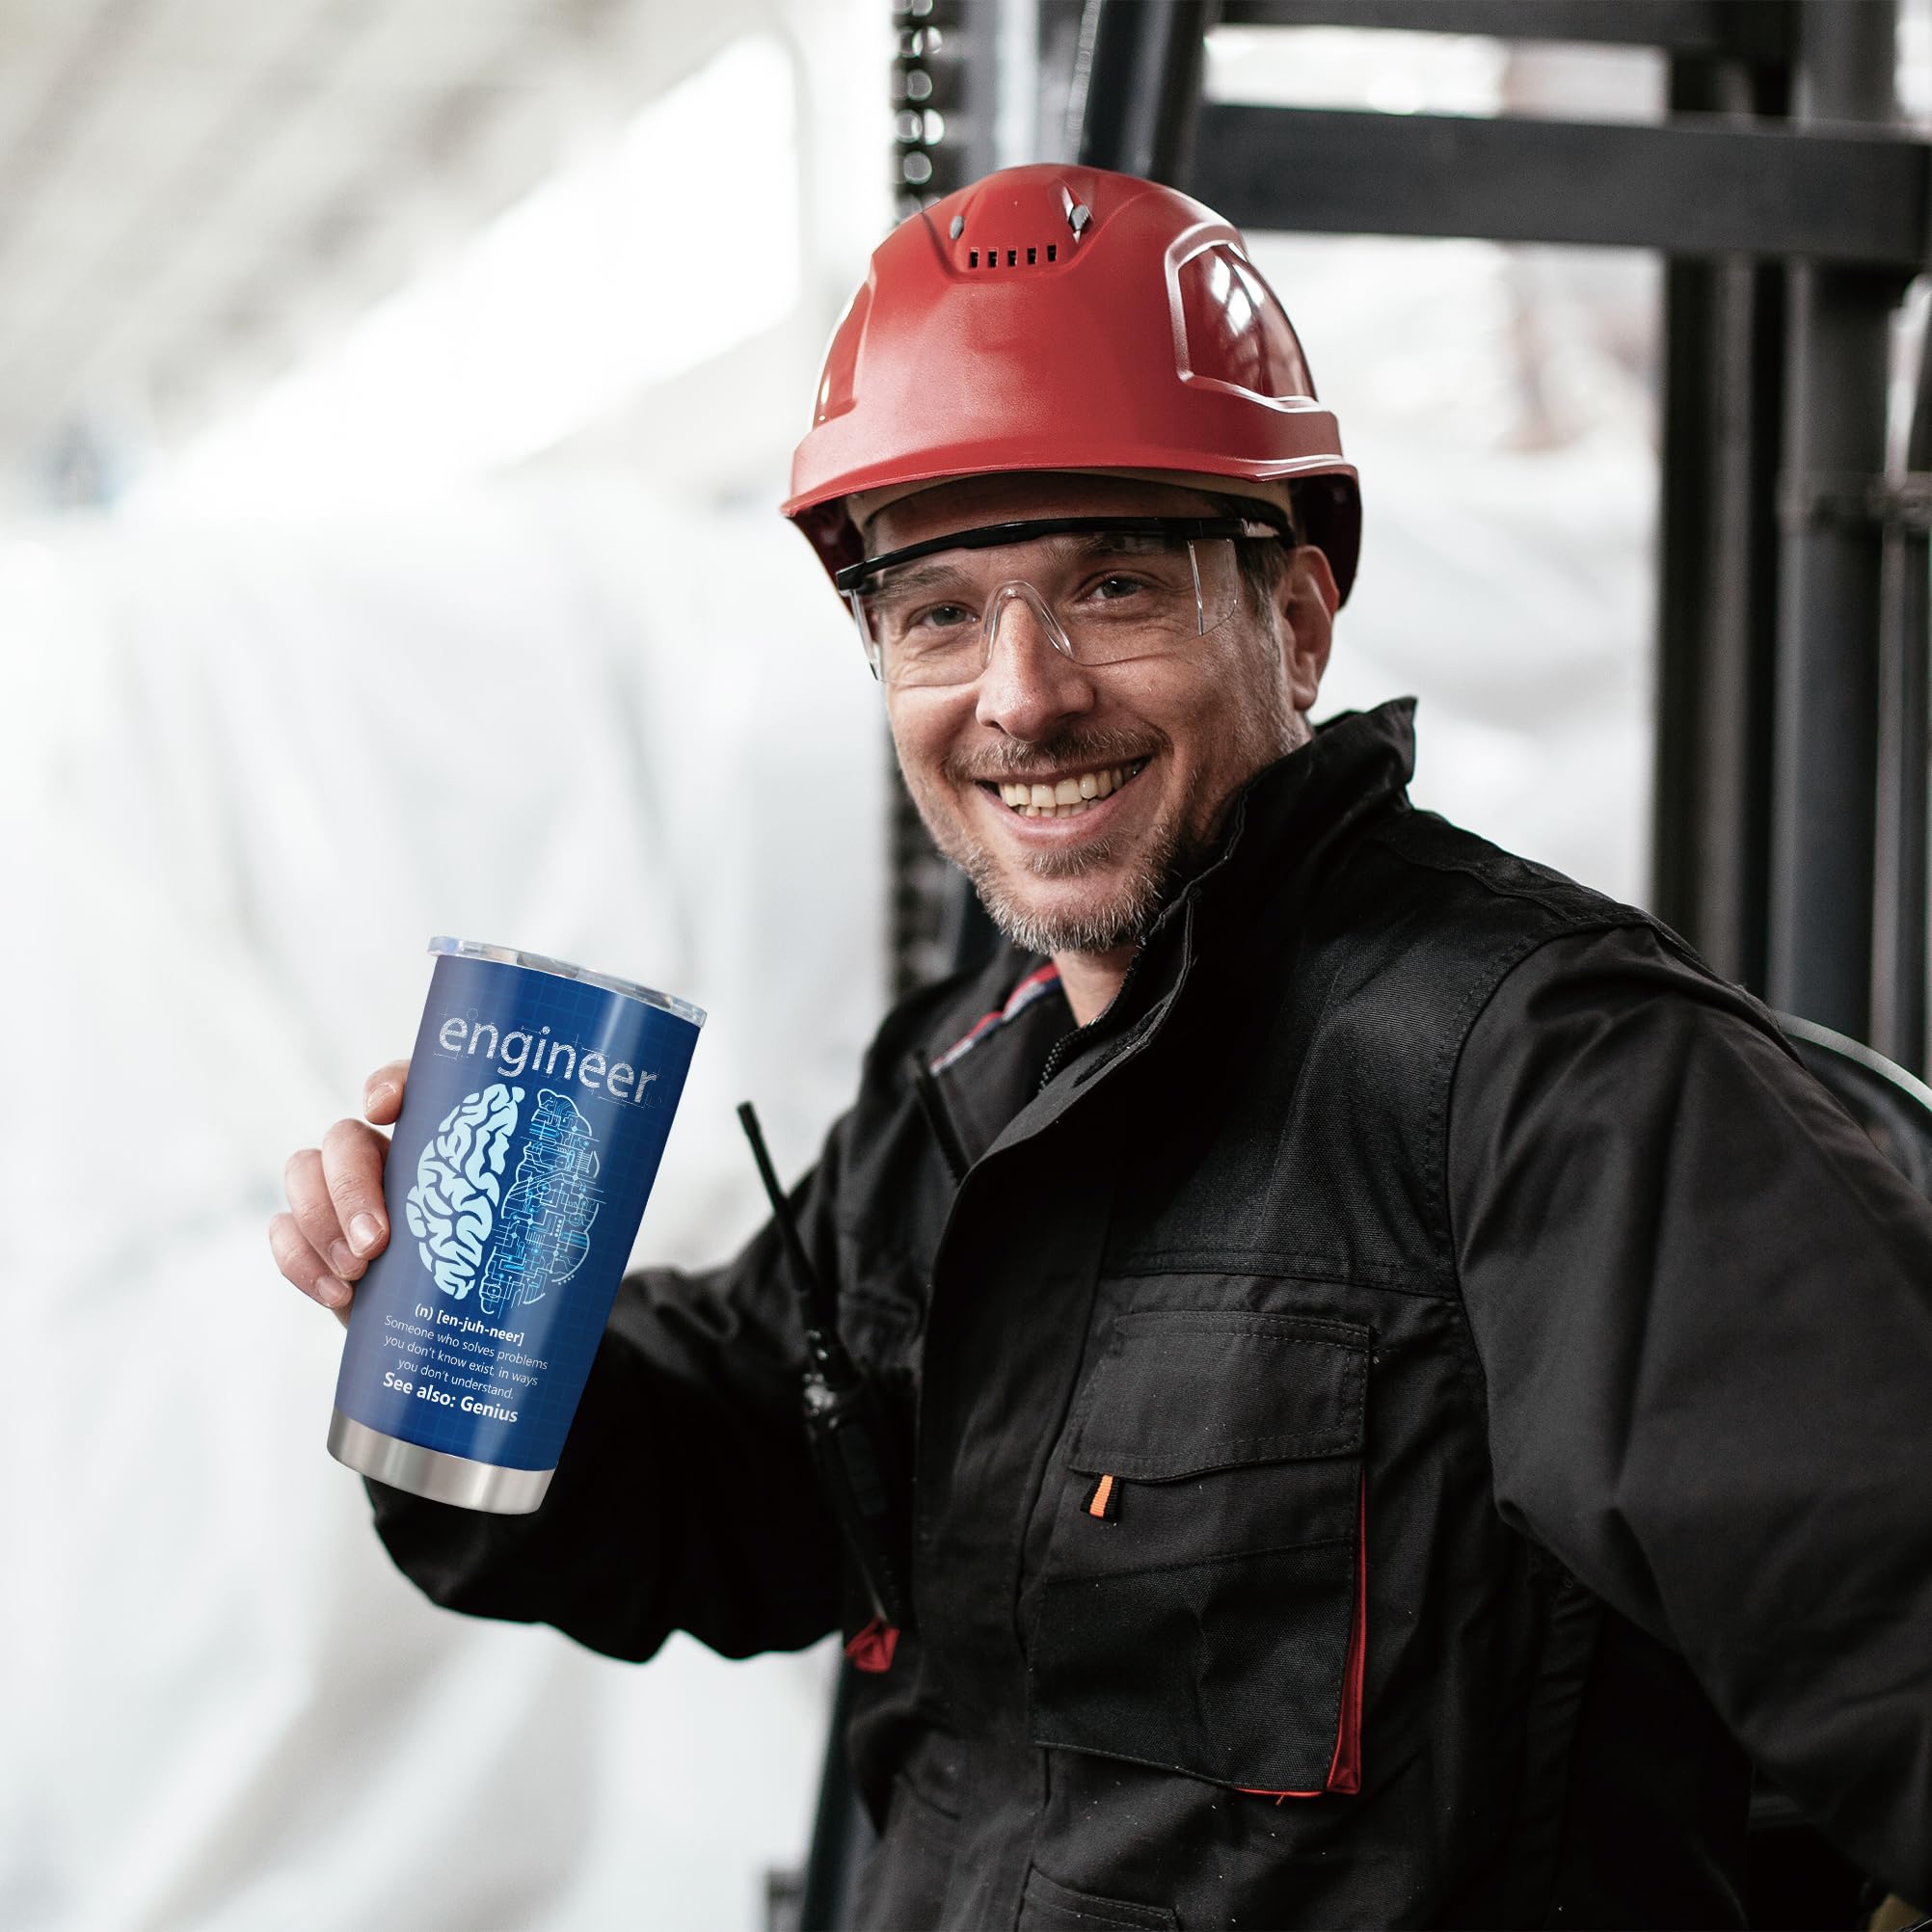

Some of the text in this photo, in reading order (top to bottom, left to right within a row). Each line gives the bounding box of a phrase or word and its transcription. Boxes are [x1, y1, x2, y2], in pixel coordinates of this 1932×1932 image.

[439, 1017, 657, 1103] engineer
[384, 1315, 549, 1371] Someone who solves problems
[415, 1303, 524, 1347] (n) [en-juh-neer]
[384, 1334, 539, 1387] you don't know exist, in ways
[396, 1357, 514, 1400] you don't understand.
[383, 1371, 519, 1423] See also: Genius
